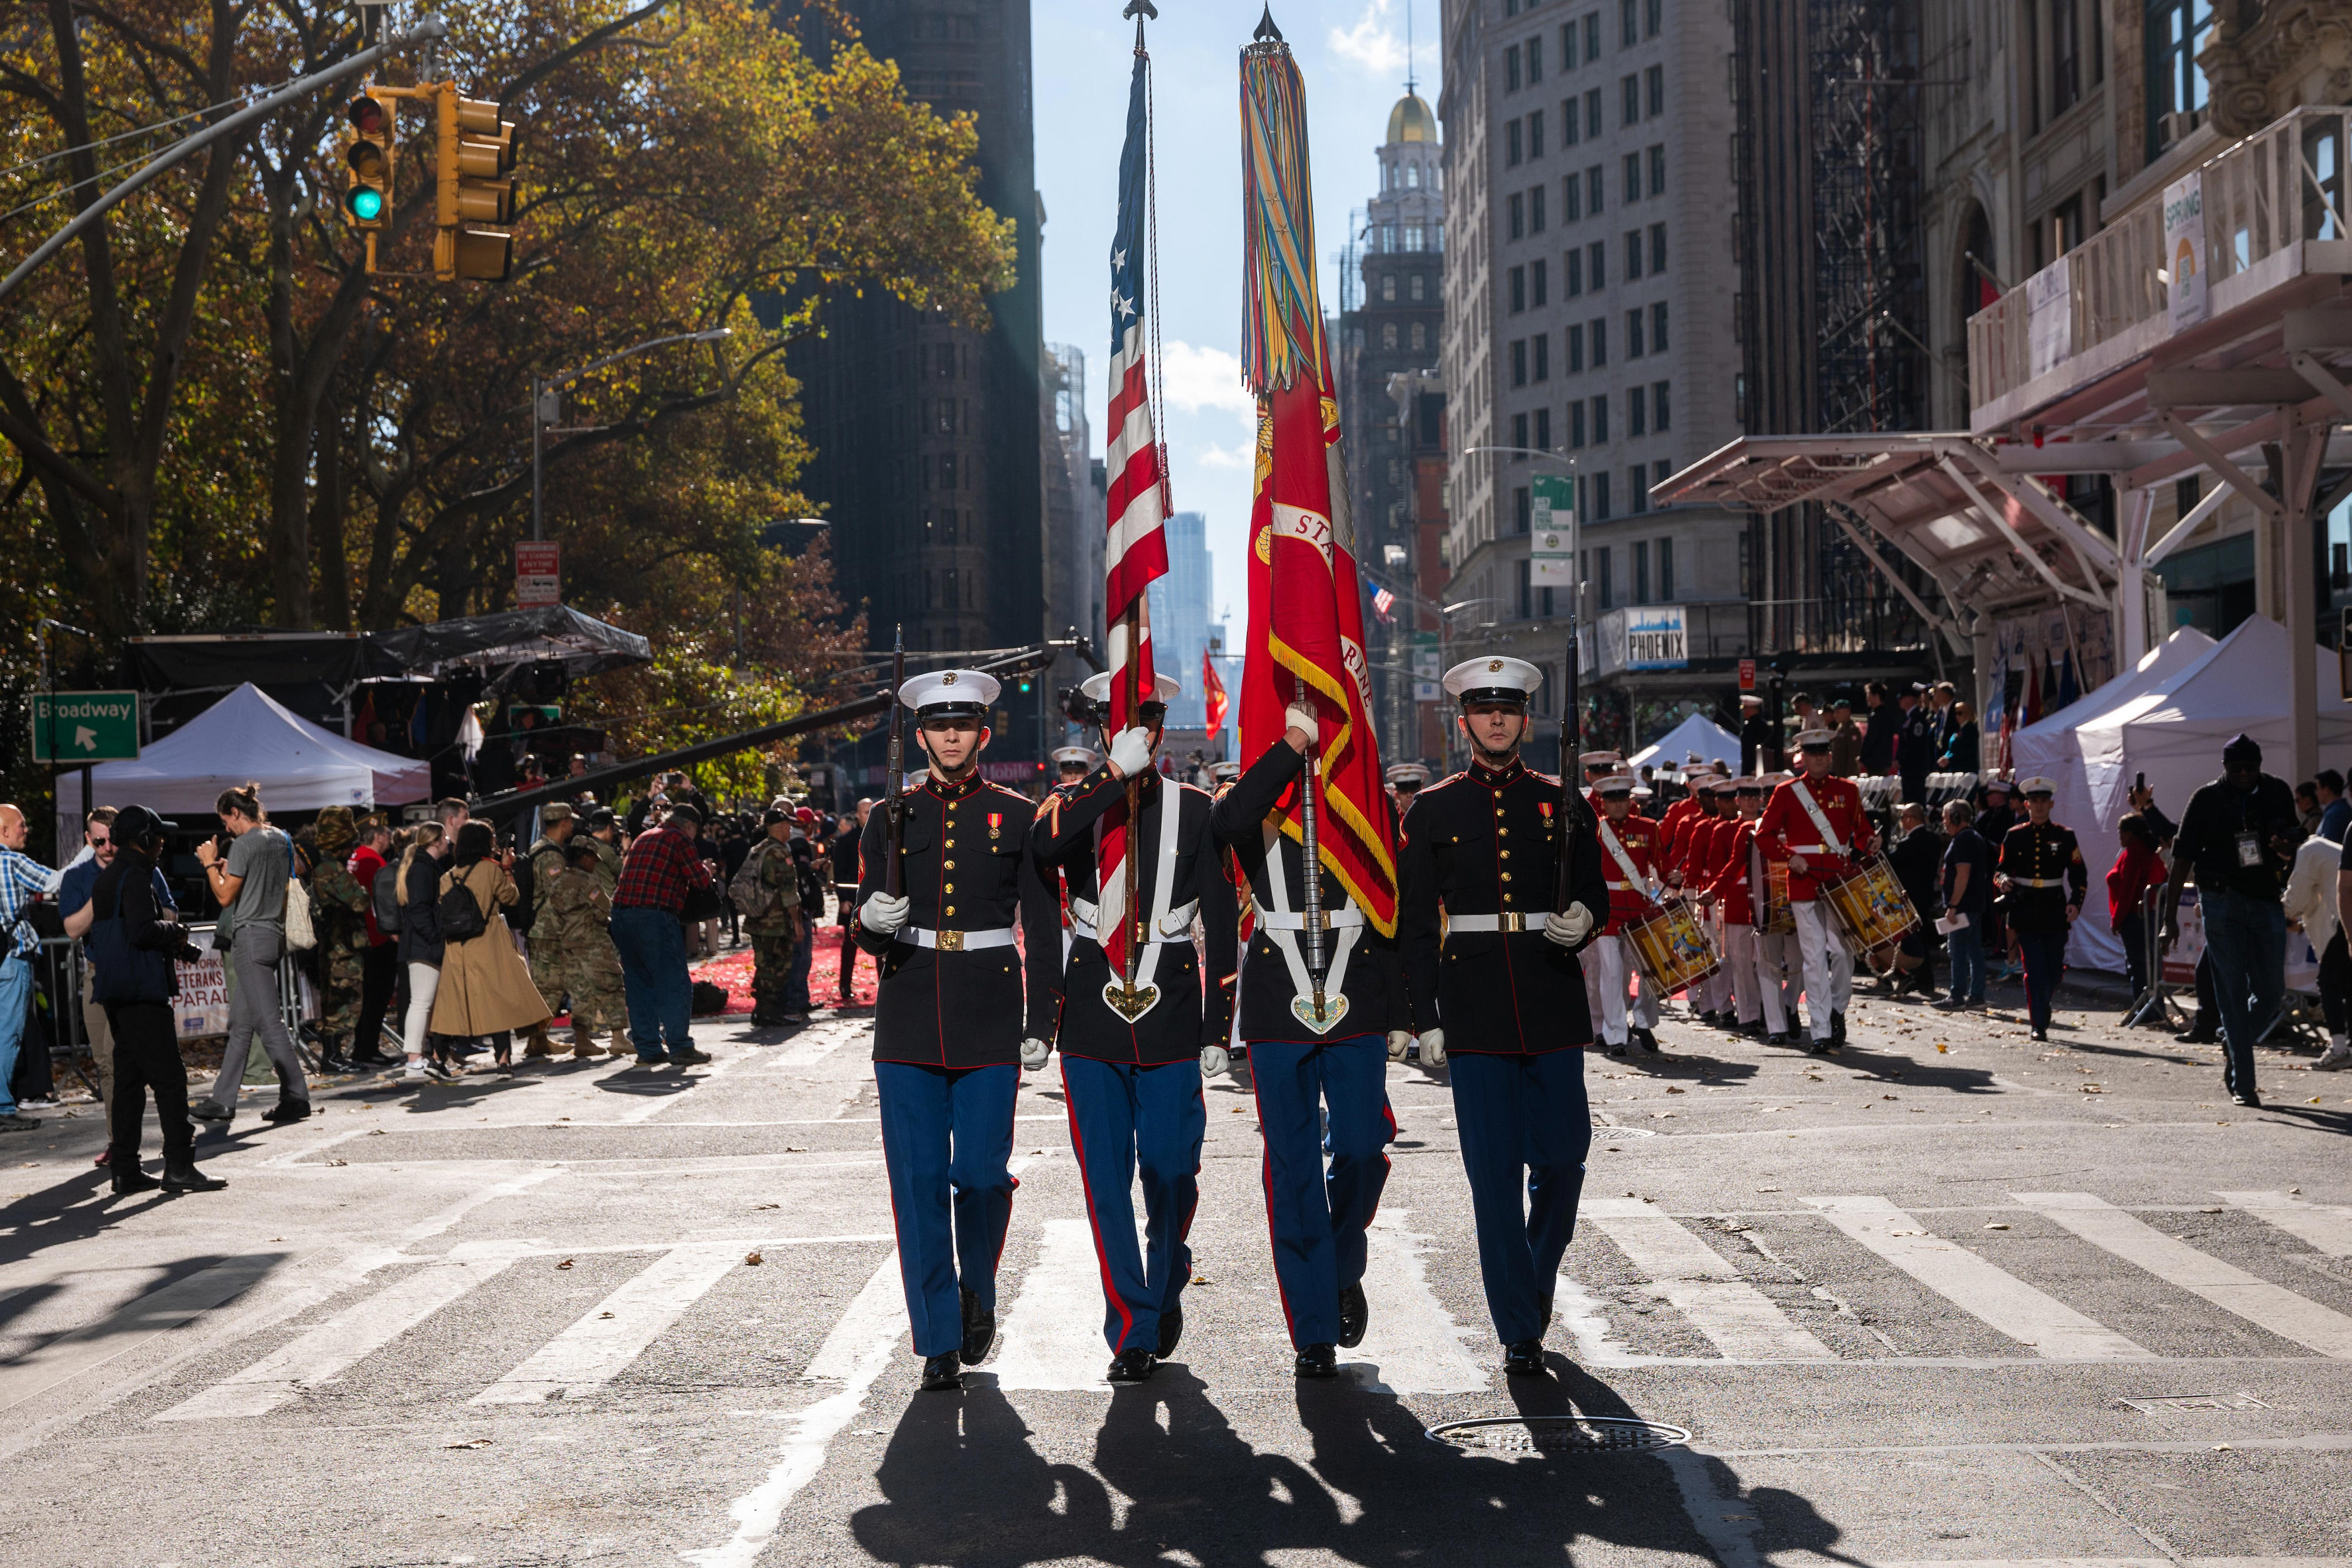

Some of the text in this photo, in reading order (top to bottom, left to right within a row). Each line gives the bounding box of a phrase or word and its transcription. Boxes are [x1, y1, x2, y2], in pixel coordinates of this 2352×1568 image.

[1295, 514, 1334, 560] STA
[1629, 632, 1684, 660] PHOENIX
[1343, 644, 1371, 707] RINE
[176, 959, 191, 971] EW
[176, 970, 223, 989] ETERANS
[172, 987, 229, 1008] PARAD
